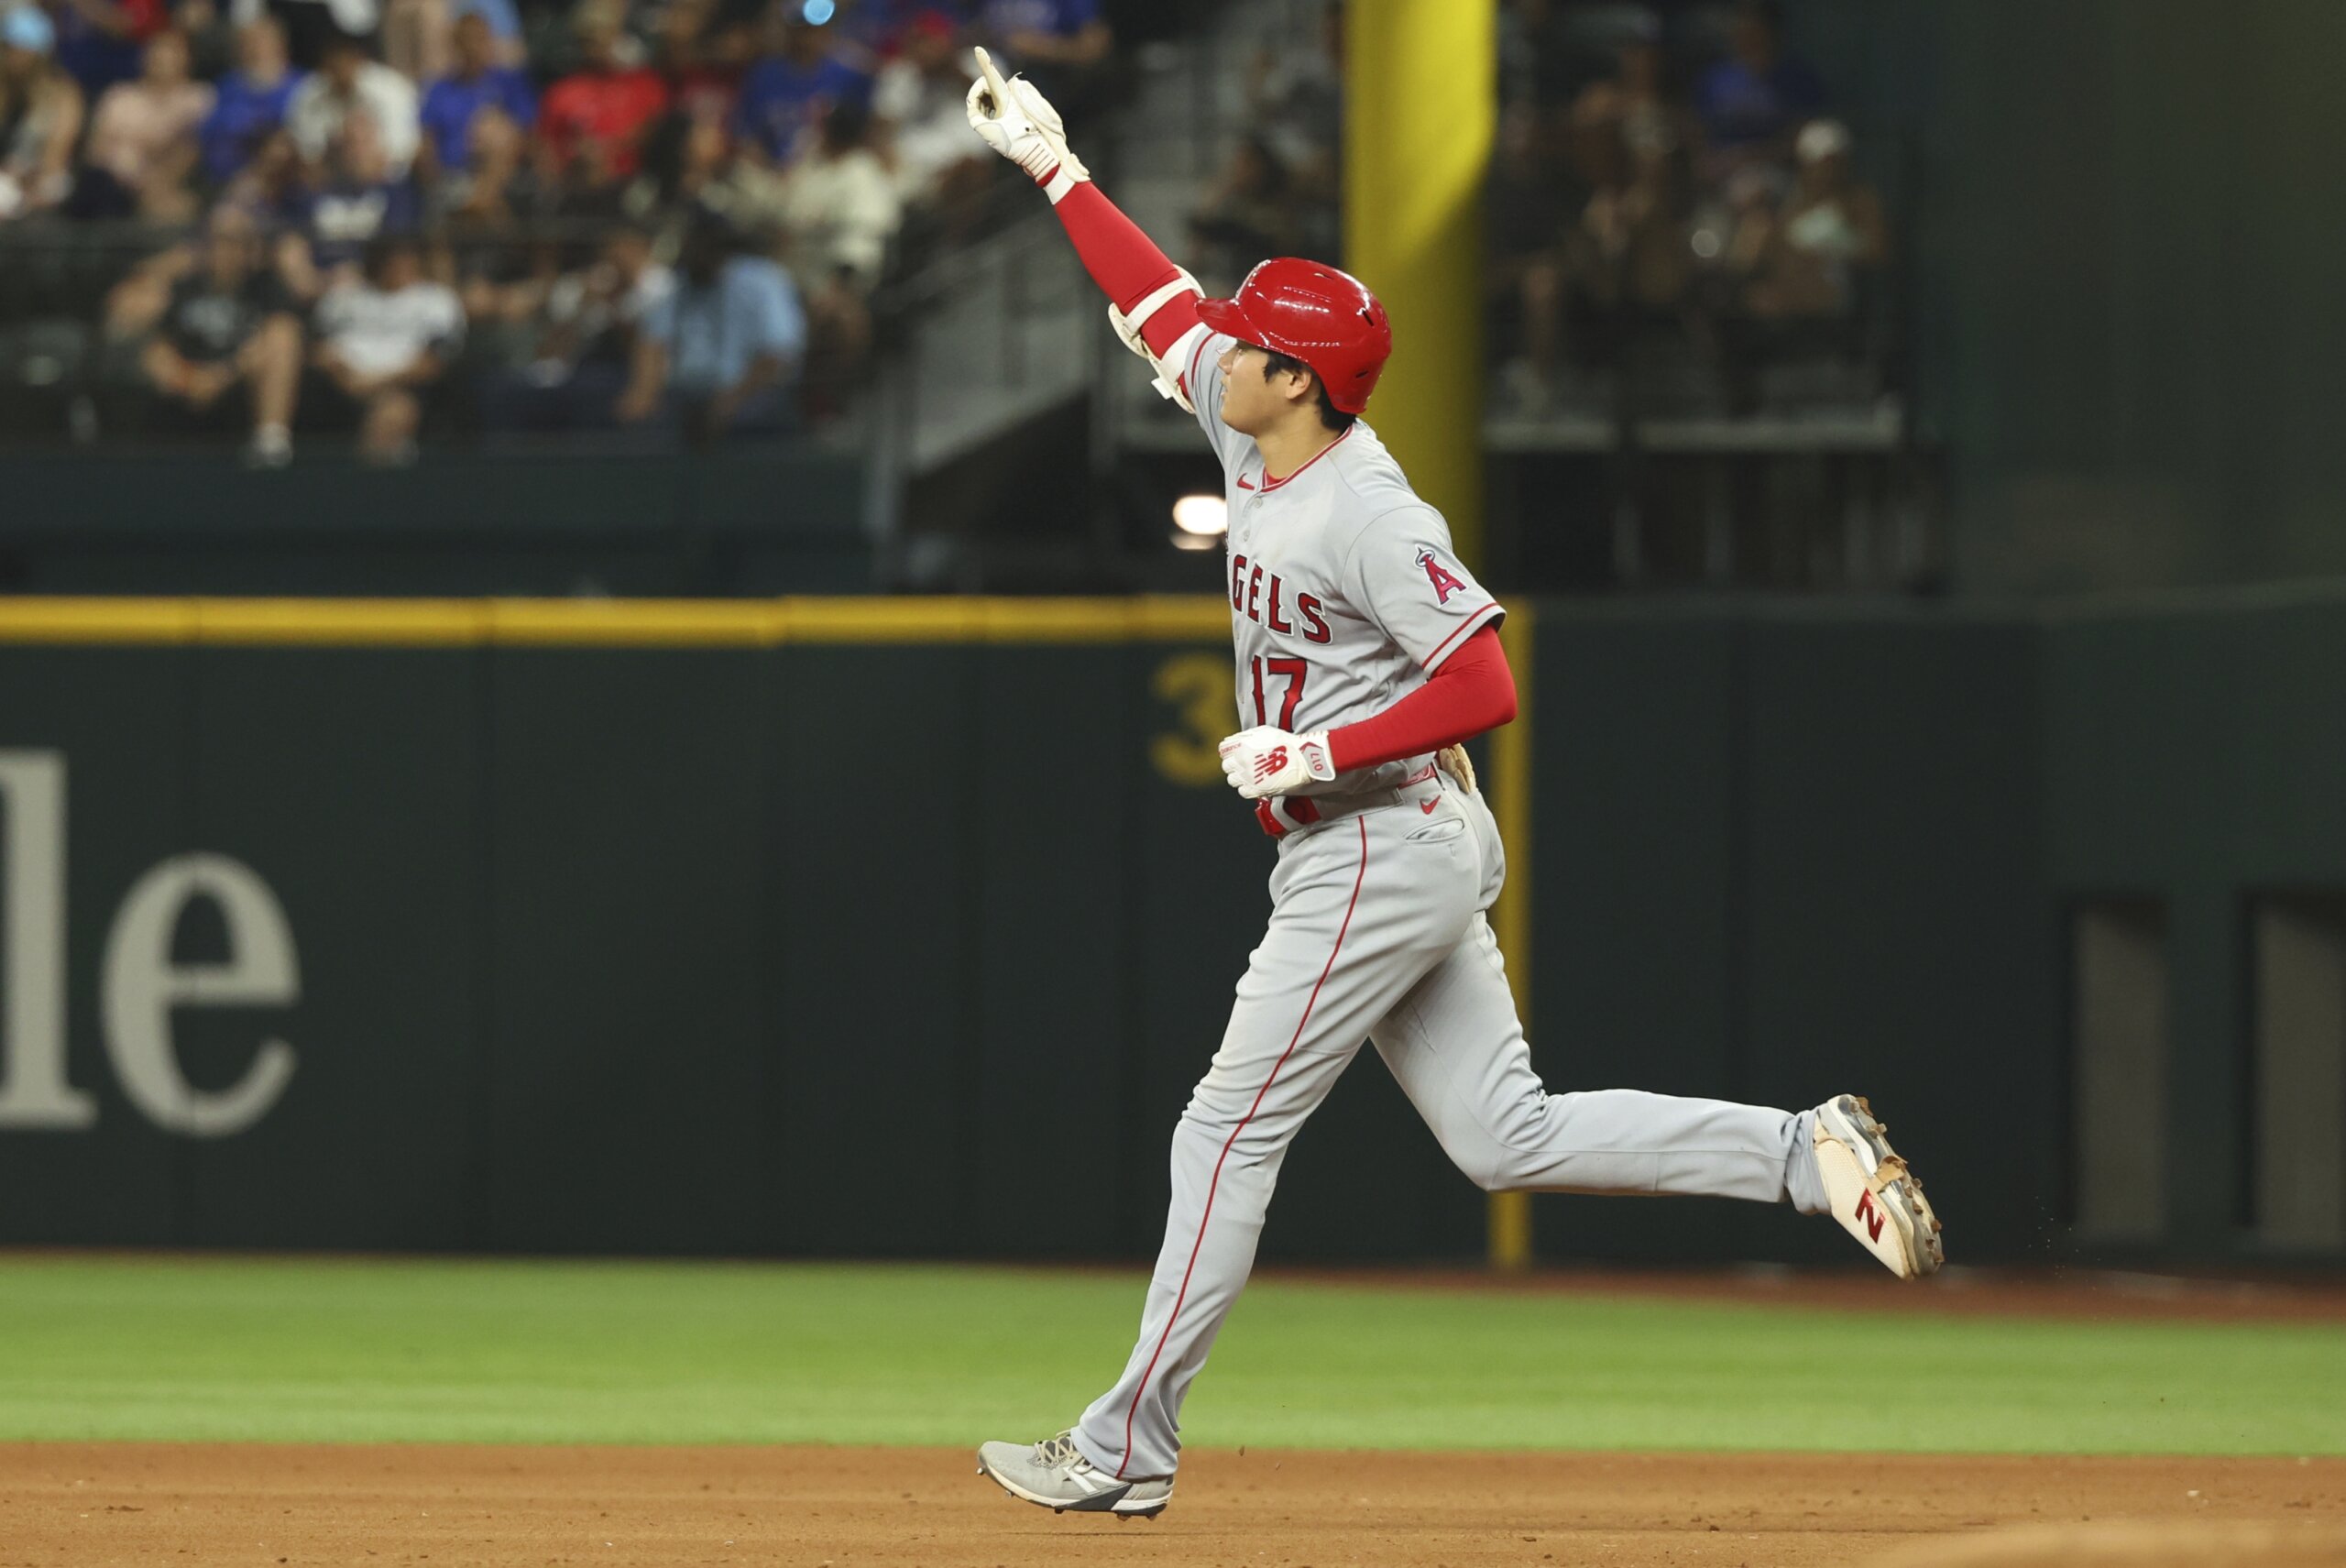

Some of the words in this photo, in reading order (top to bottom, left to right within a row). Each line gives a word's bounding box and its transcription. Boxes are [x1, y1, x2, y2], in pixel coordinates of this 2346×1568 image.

[1231, 554, 1332, 644] GELS
[1418, 551, 1467, 605] A
[1152, 655, 1235, 788] 3
[1252, 654, 1308, 733] 17
[0, 749, 300, 1136] le
